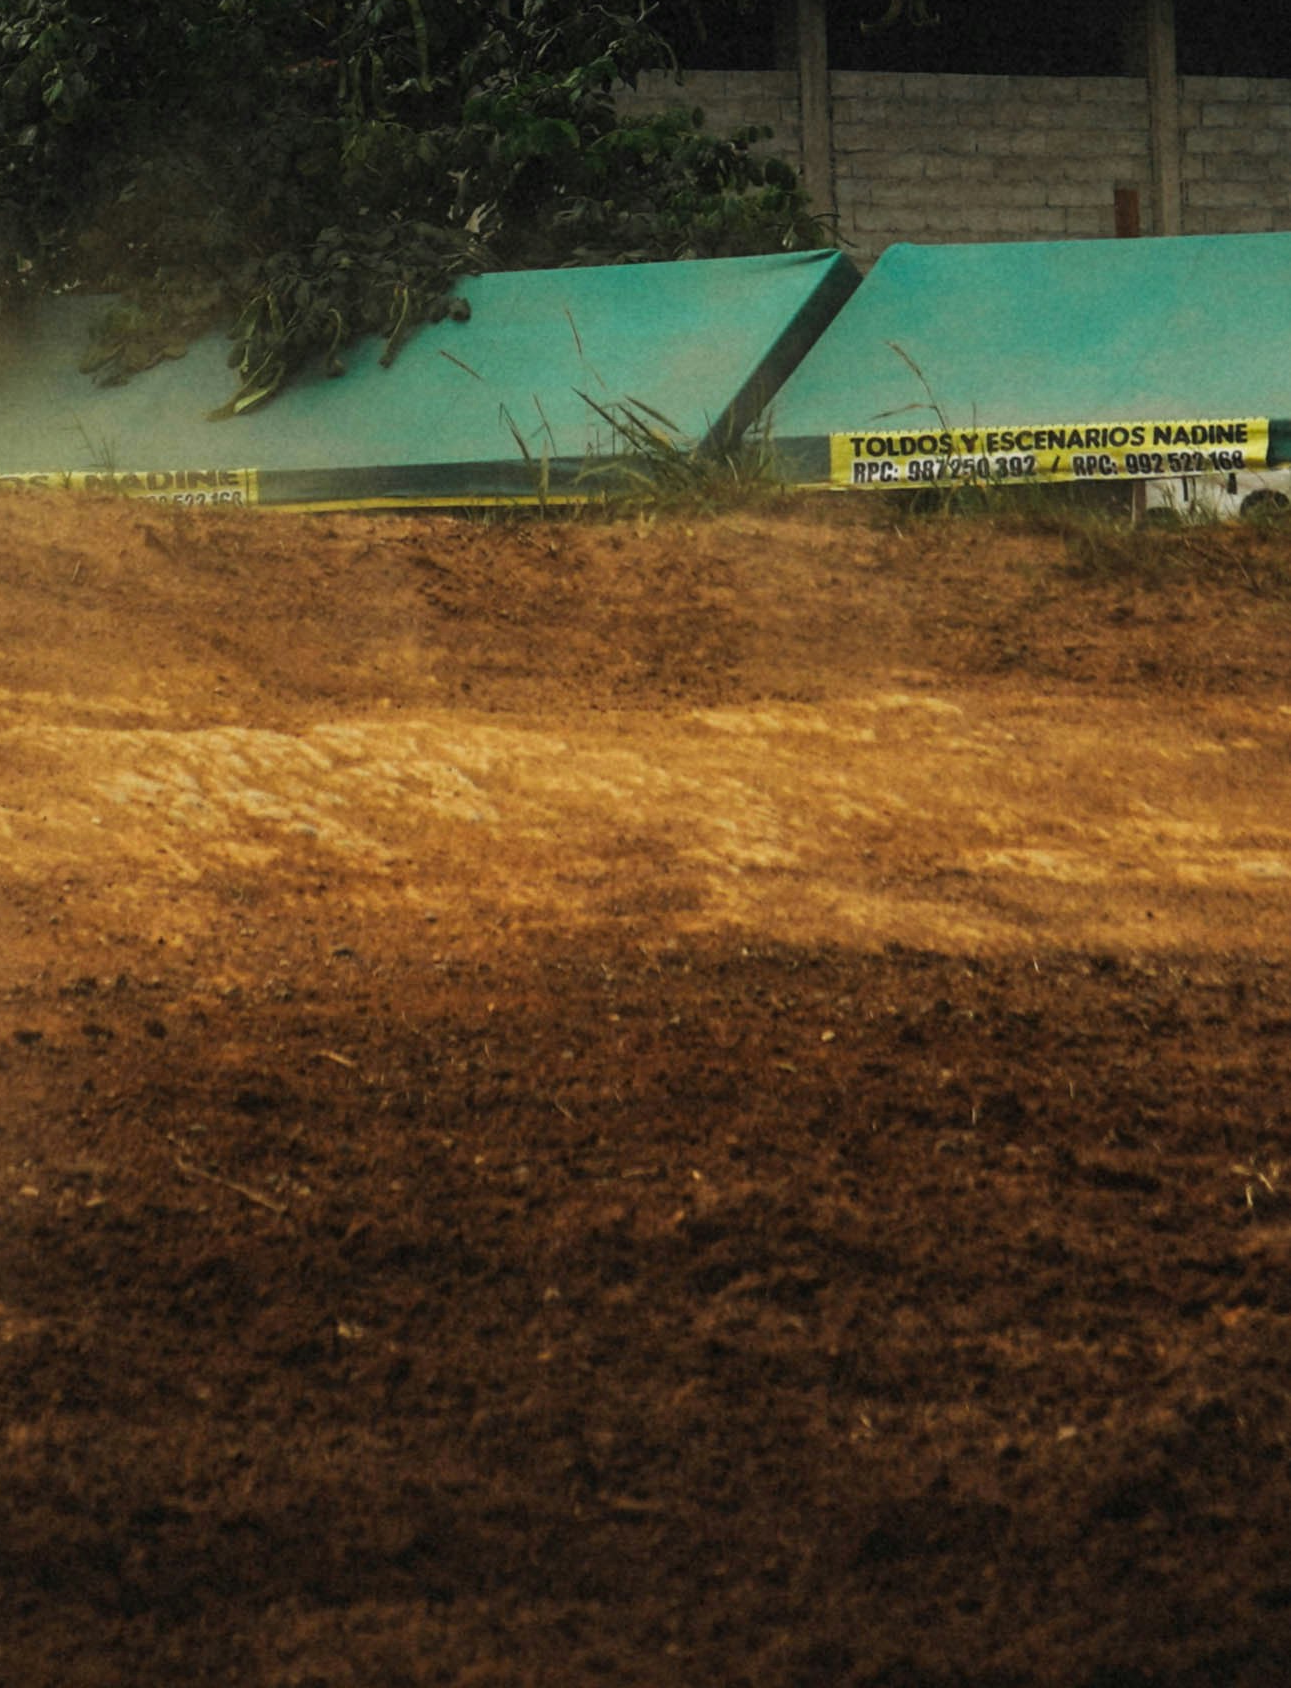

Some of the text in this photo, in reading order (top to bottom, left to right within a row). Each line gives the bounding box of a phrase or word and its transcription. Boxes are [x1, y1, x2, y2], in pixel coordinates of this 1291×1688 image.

[850, 423, 1248, 457] TOLDOS Y ESCENARIOS NADINE
[853, 461, 899, 484] RPC:
[1073, 454, 1119, 477] RPC:
[1125, 452, 1164, 475] 992
[1209, 450, 1246, 470] 168
